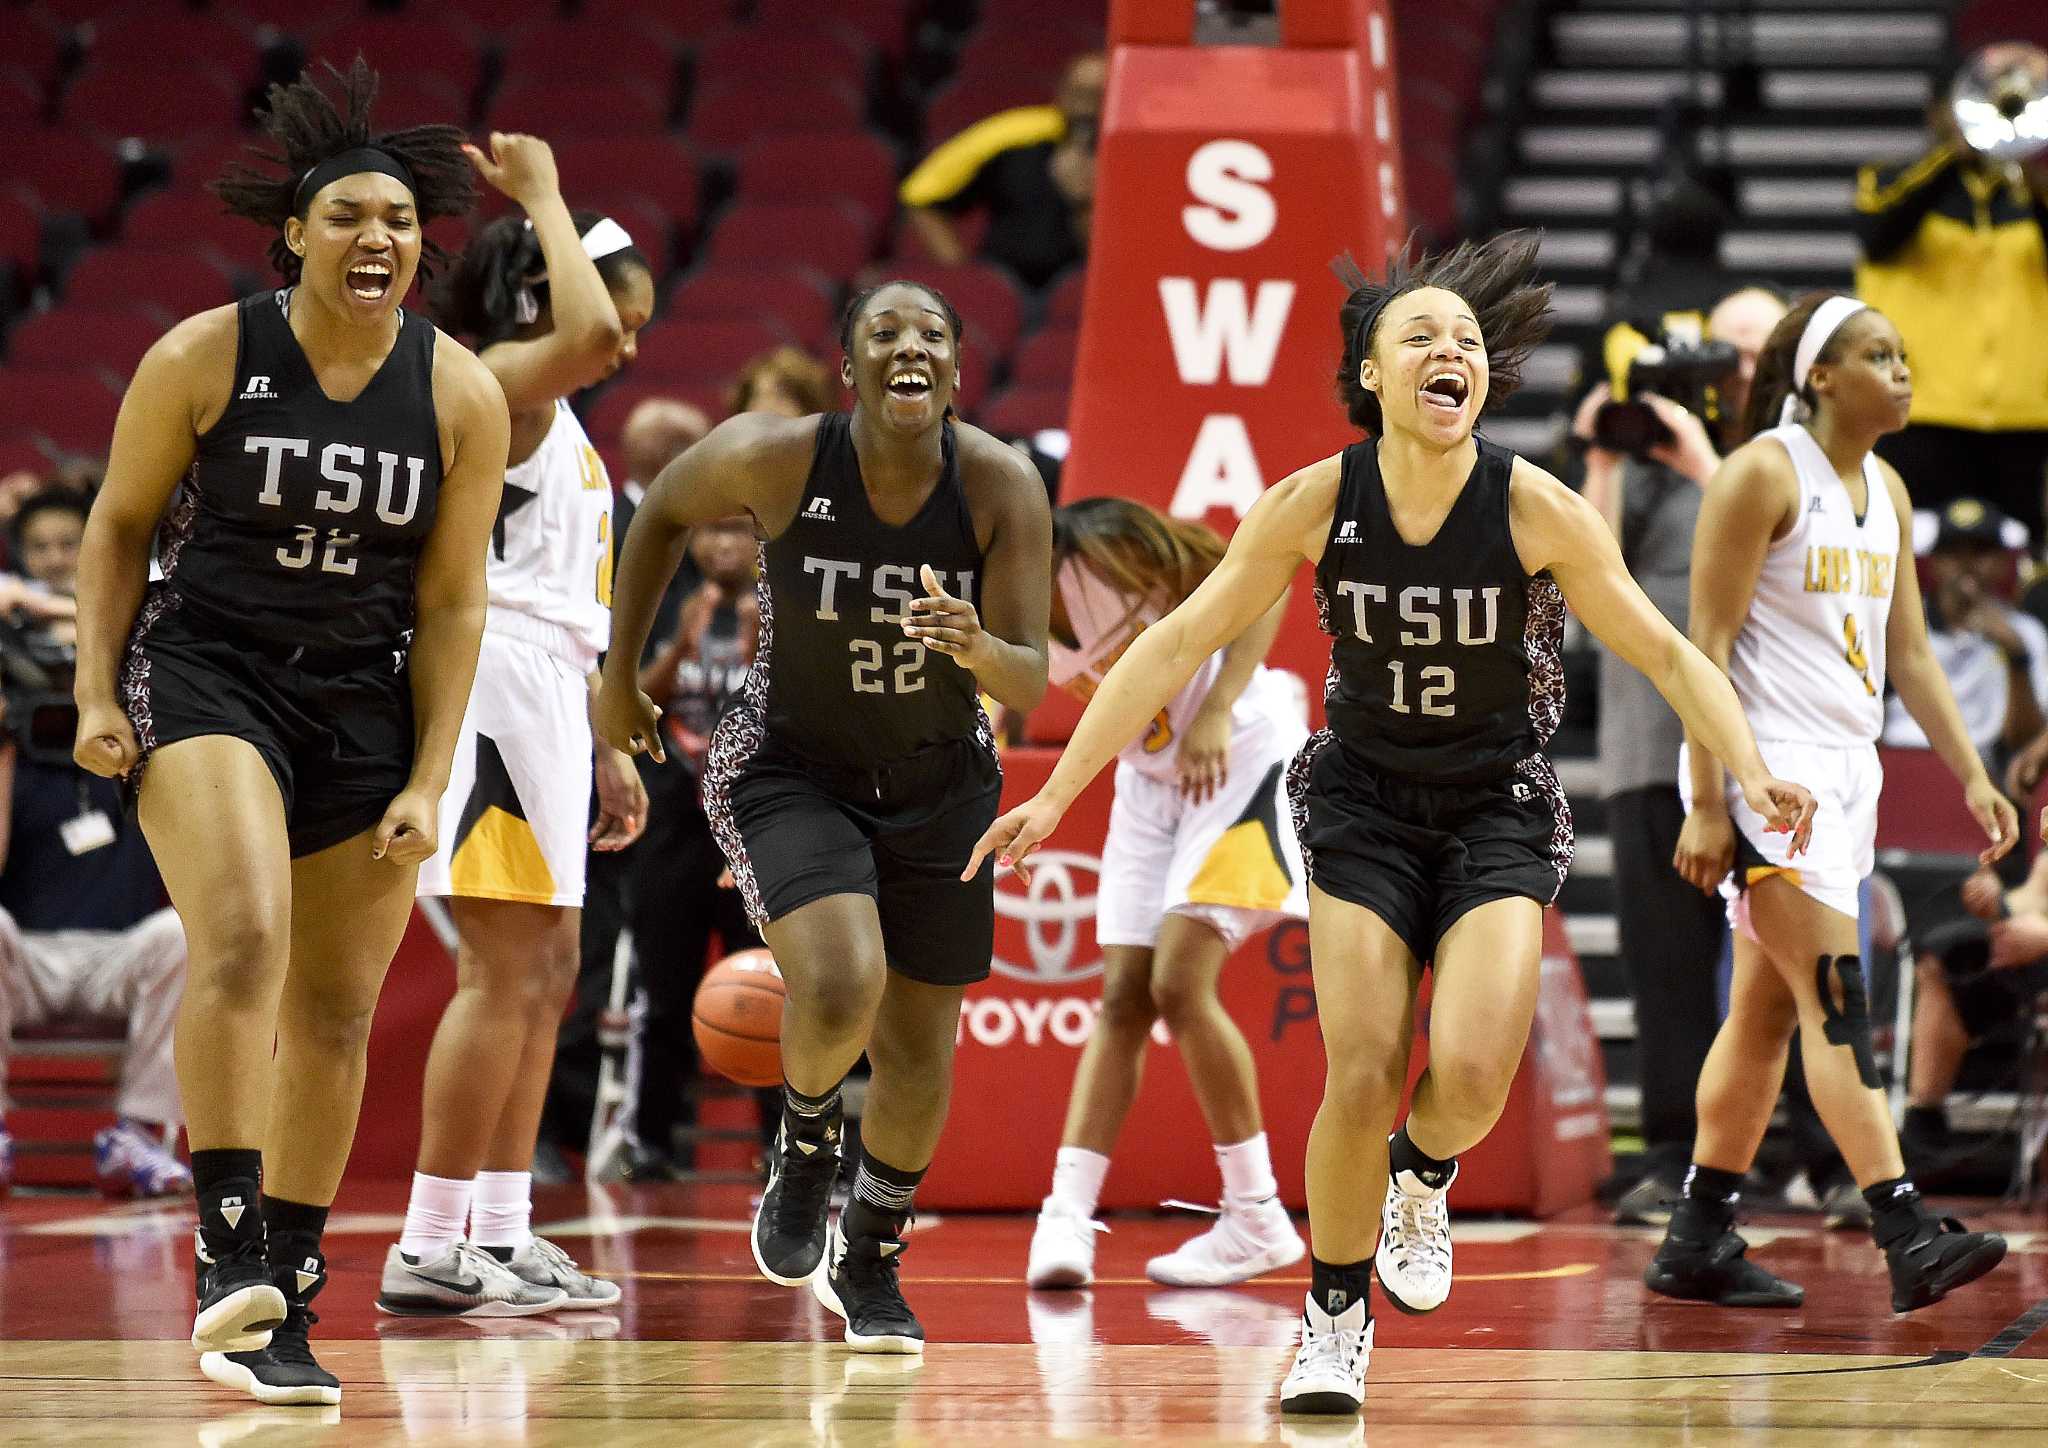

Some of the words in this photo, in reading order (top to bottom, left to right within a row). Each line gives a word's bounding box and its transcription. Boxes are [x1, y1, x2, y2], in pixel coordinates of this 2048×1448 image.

[239, 392, 279, 400] RUSSELL
[244, 433, 425, 525] TSU
[801, 511, 836, 522] RUSSELL
[276, 523, 361, 576] 32
[1336, 580, 1501, 646] TSU
[849, 638, 926, 694] 22
[1387, 660, 1456, 717] 12
[955, 996, 1172, 1046] OYO
